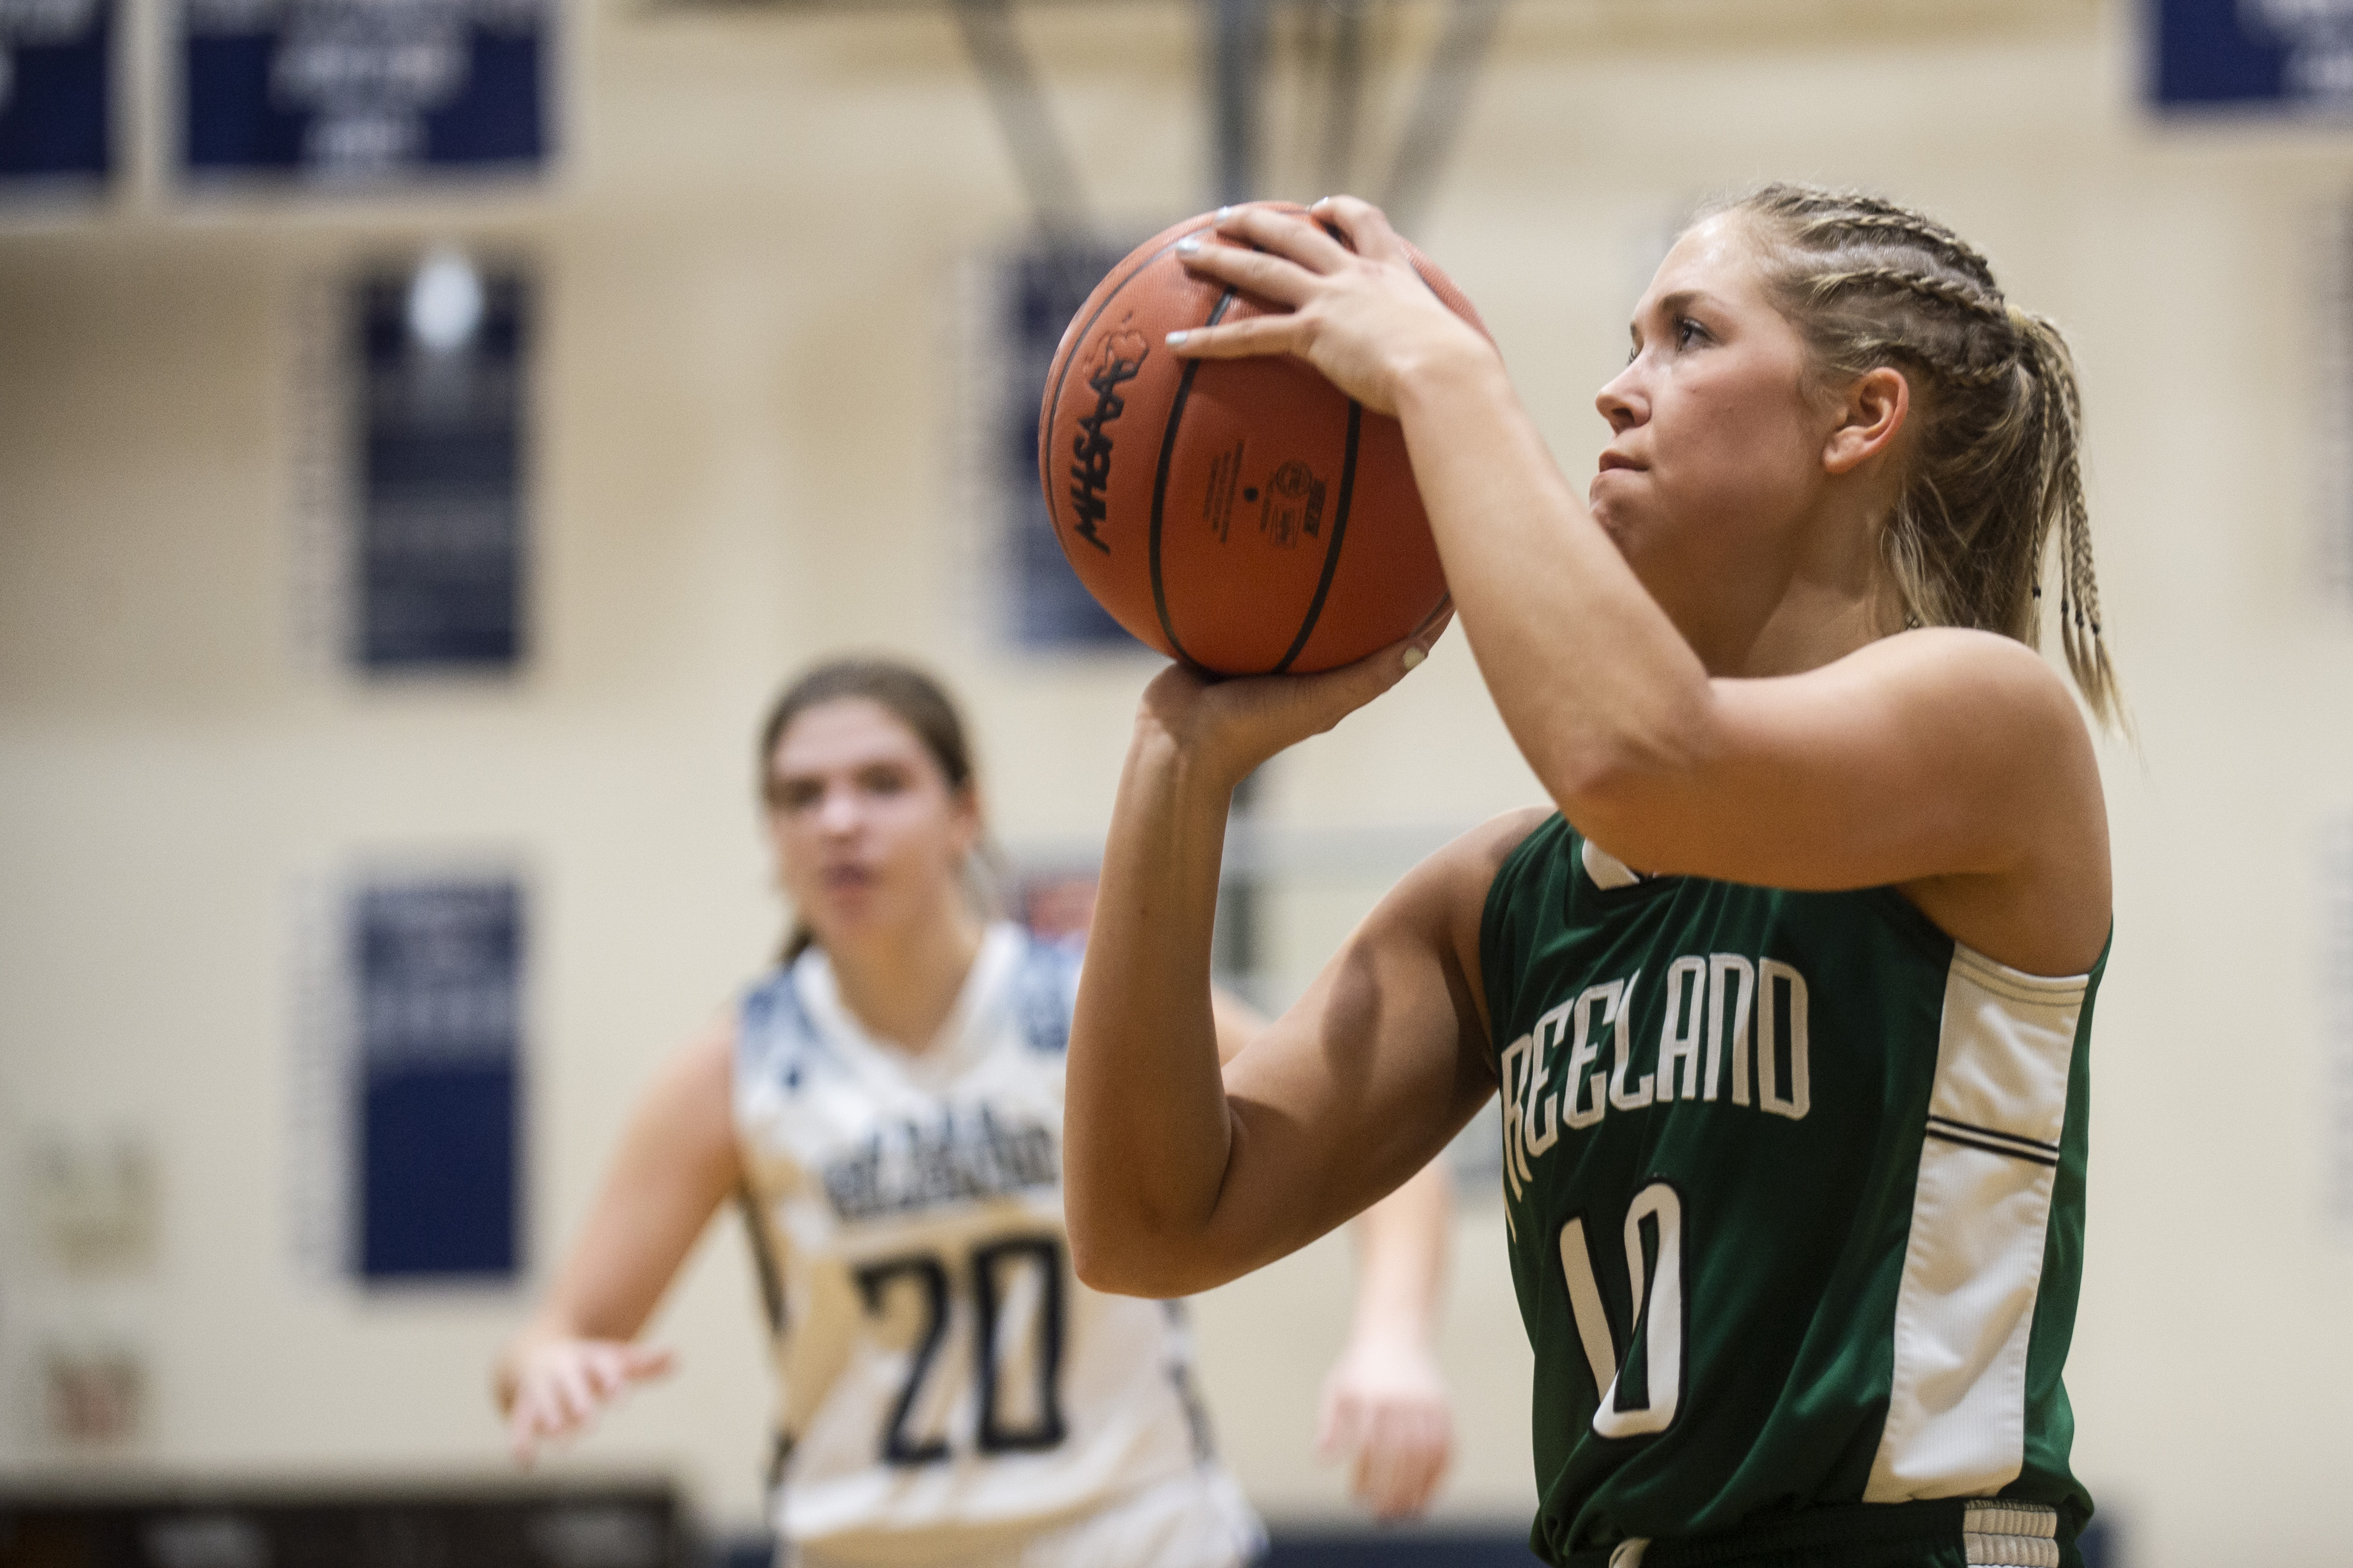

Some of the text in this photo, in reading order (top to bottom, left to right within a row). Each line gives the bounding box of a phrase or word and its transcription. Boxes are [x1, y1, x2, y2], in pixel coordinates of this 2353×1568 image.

[1501, 952, 1810, 1242] REELAND
[850, 1233, 1069, 1467] 20
[1559, 1181, 1683, 1440] 10
